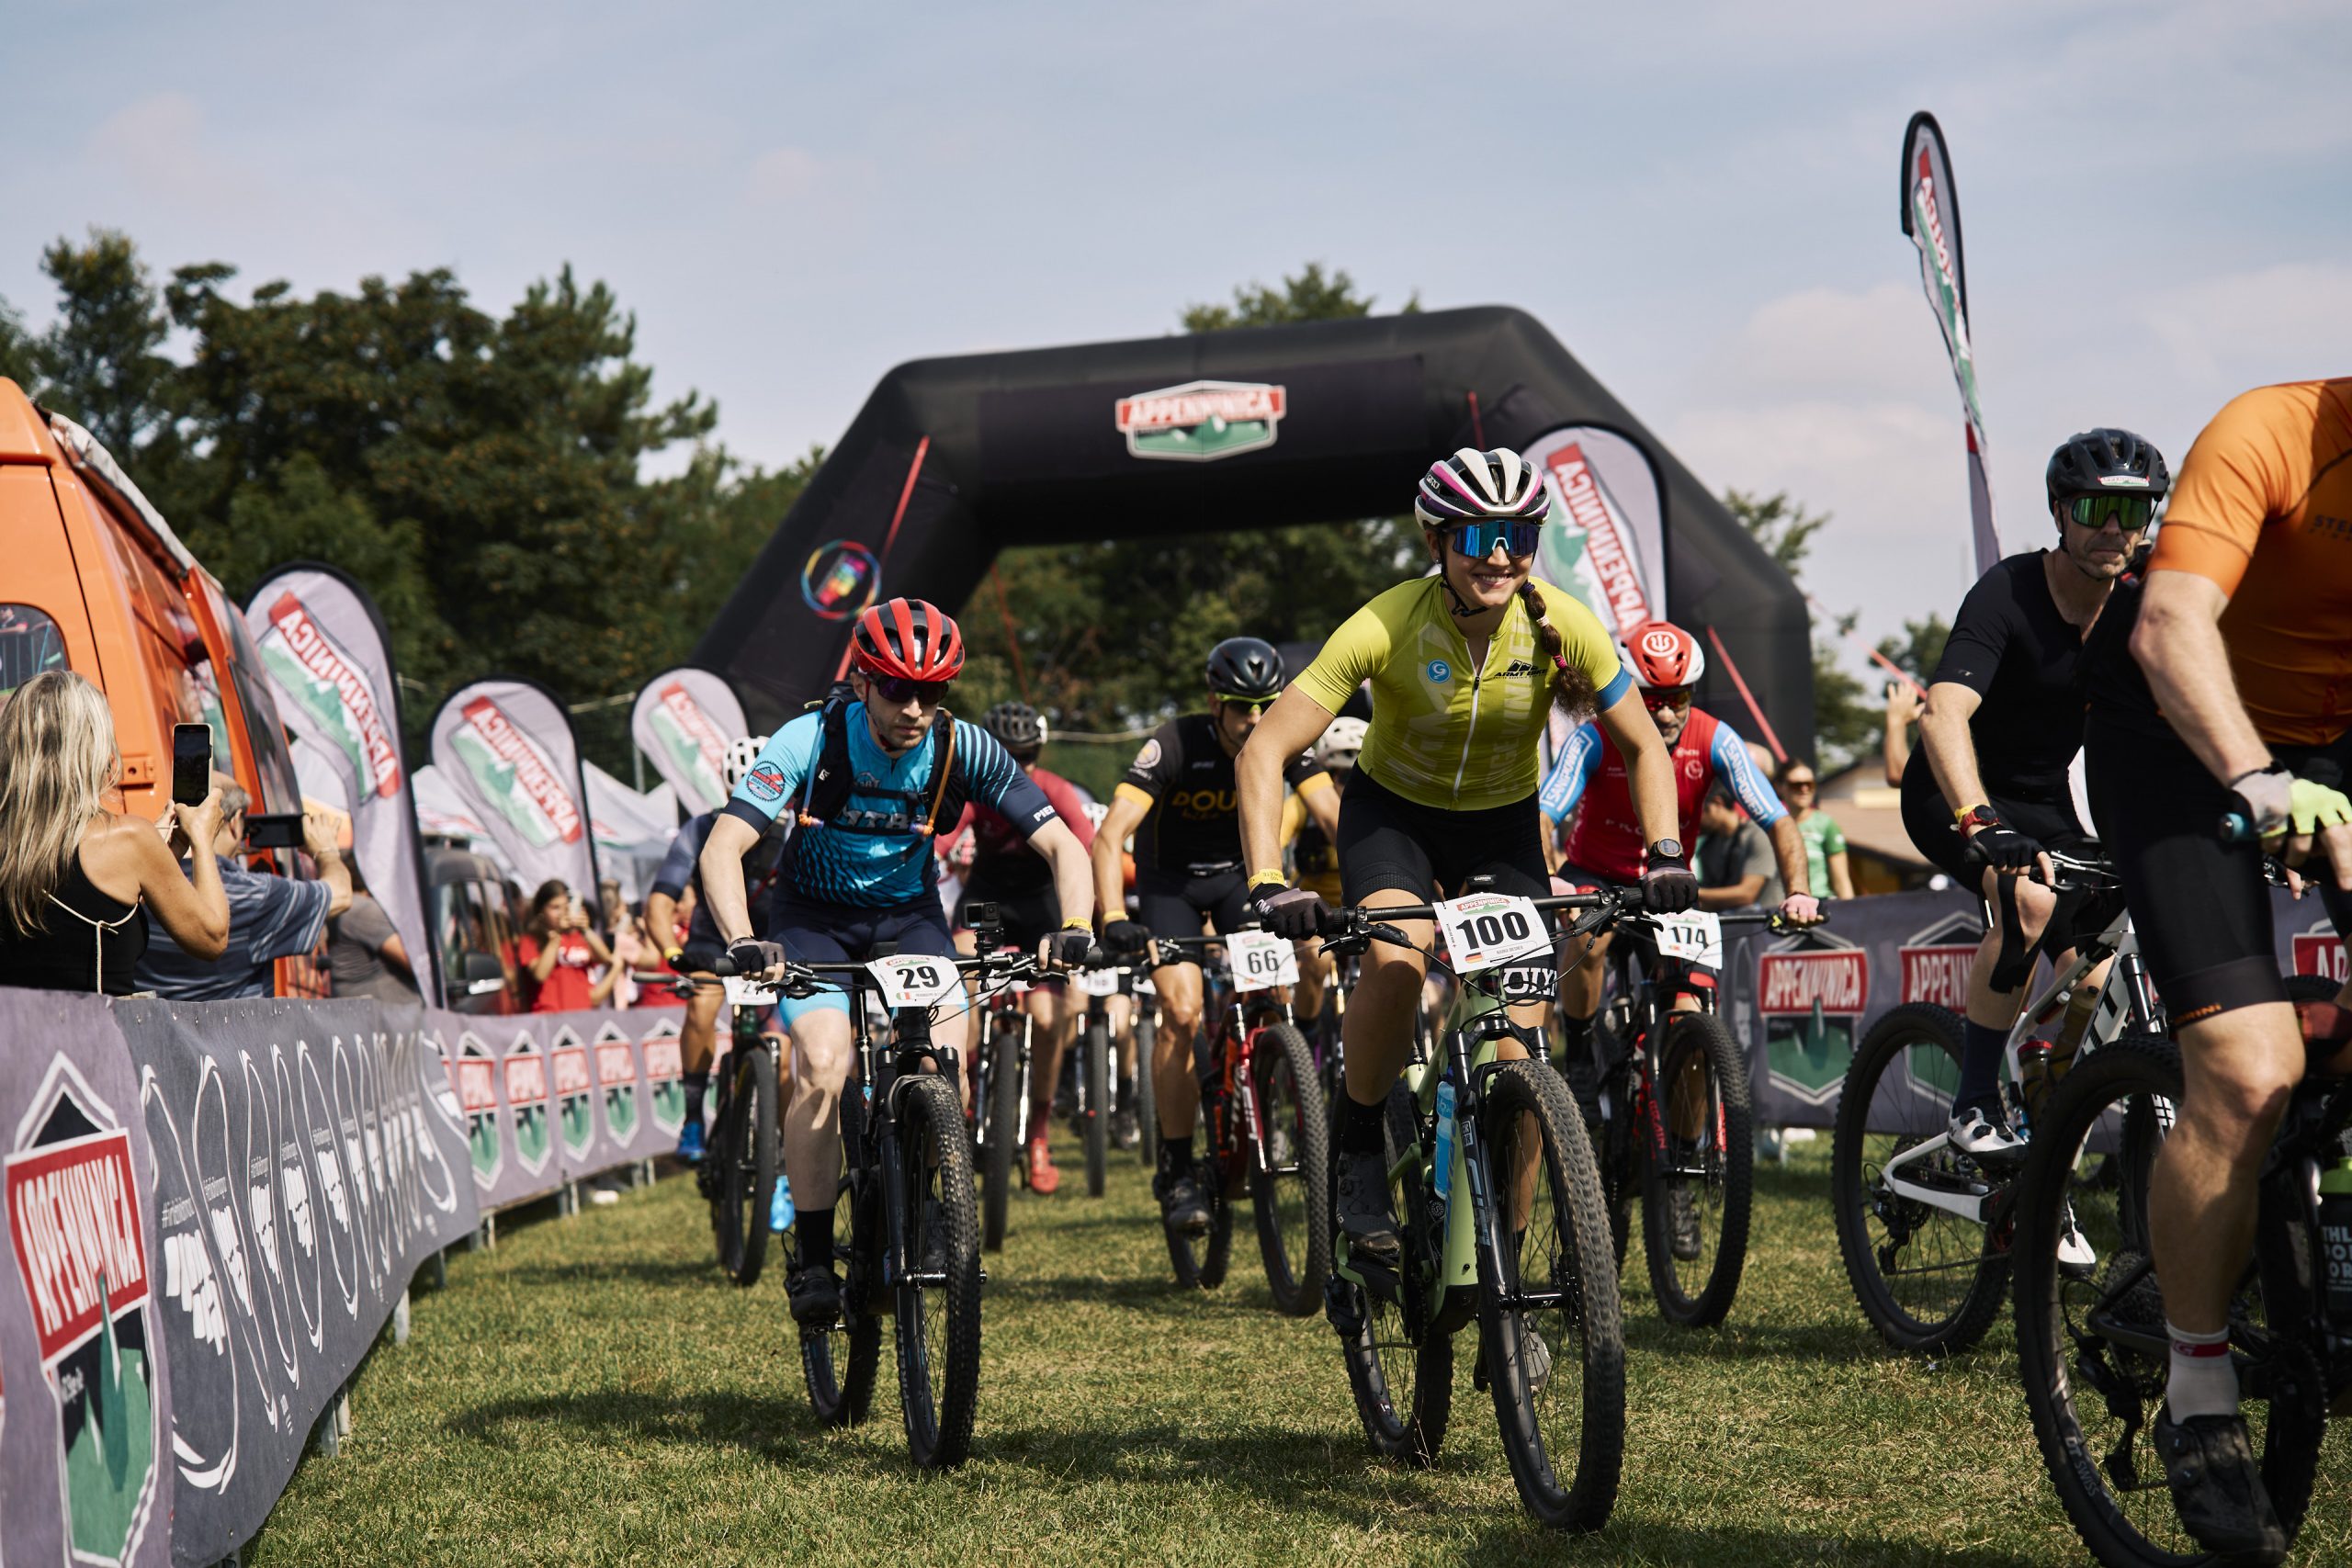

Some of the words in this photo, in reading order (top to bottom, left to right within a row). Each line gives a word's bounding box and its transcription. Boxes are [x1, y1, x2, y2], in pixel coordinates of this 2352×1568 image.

[1456, 911, 1530, 950] 100
[1668, 926, 1709, 949] 174
[1247, 950, 1280, 975] 66
[896, 965, 940, 989] 29
